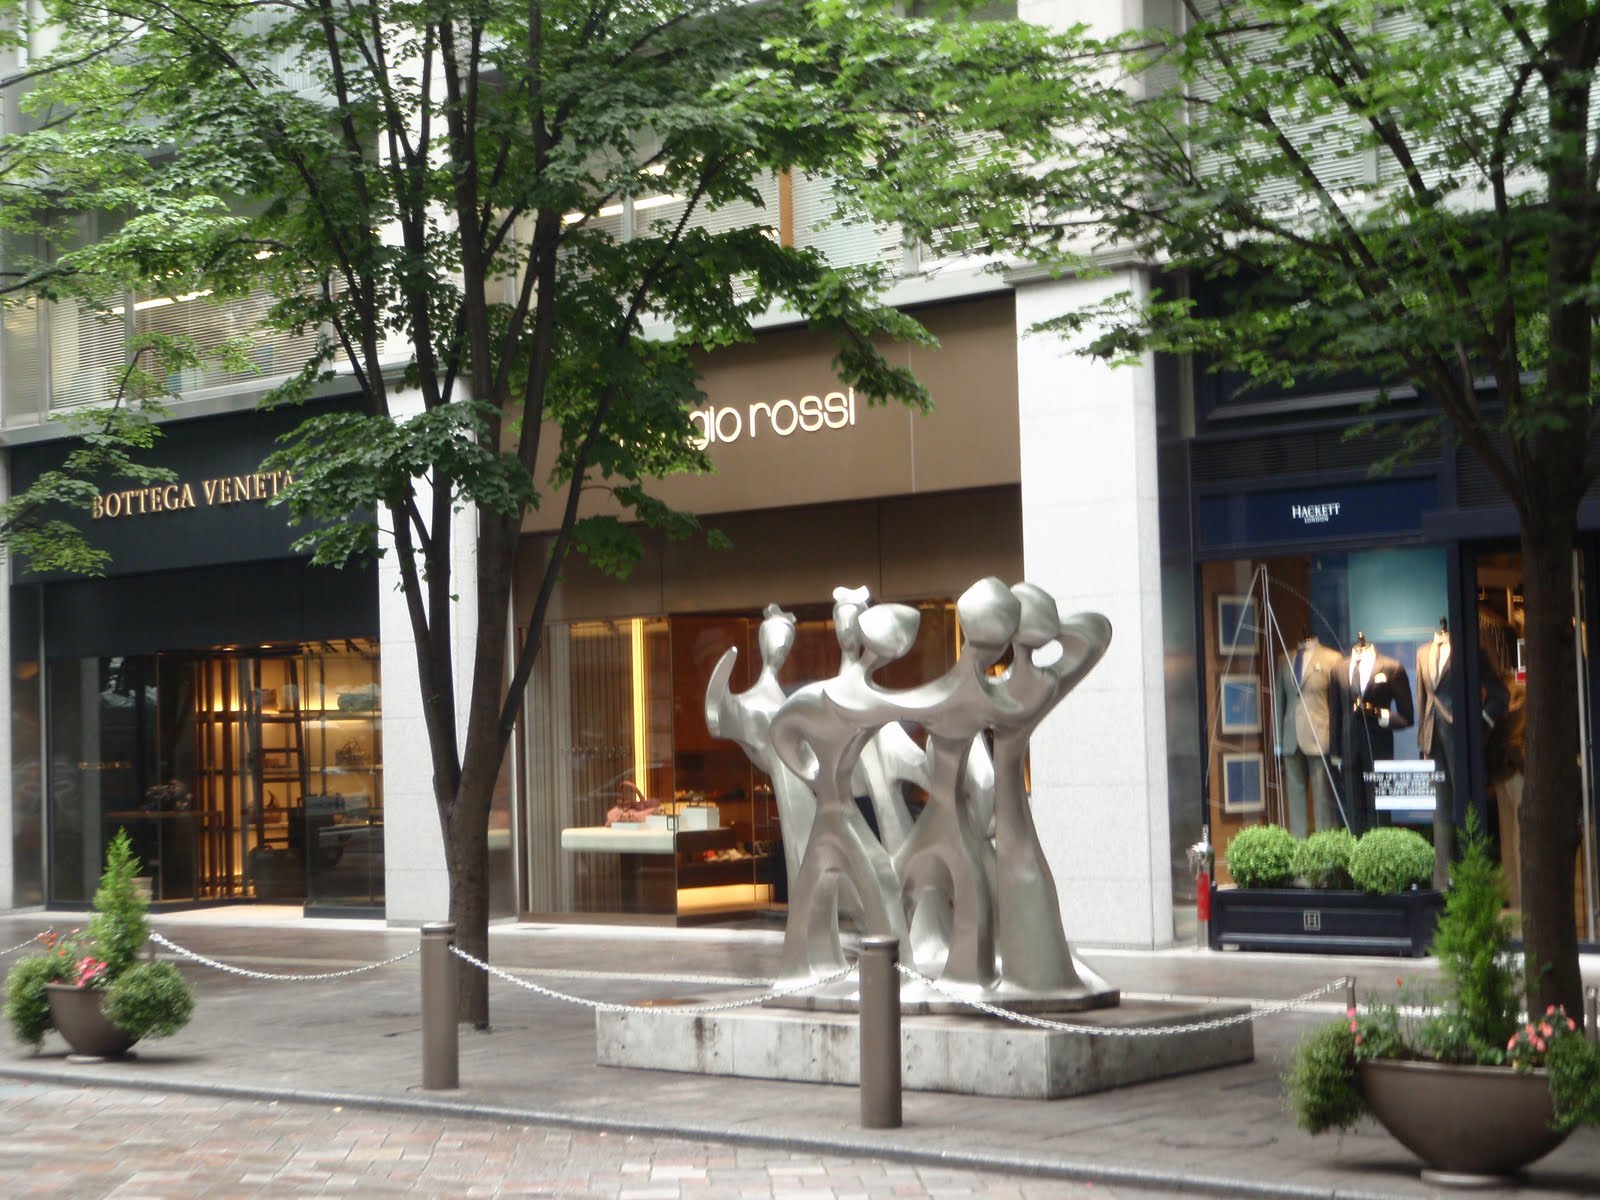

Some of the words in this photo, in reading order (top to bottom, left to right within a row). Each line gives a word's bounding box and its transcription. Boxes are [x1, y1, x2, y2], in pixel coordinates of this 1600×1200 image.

[750, 387, 855, 437] rossi
[92, 484, 196, 519] BOTTEGA
[202, 470, 294, 506] VENETA
[1292, 503, 1340, 518] HACKETT
[1304, 514, 1329, 524] LONDON
